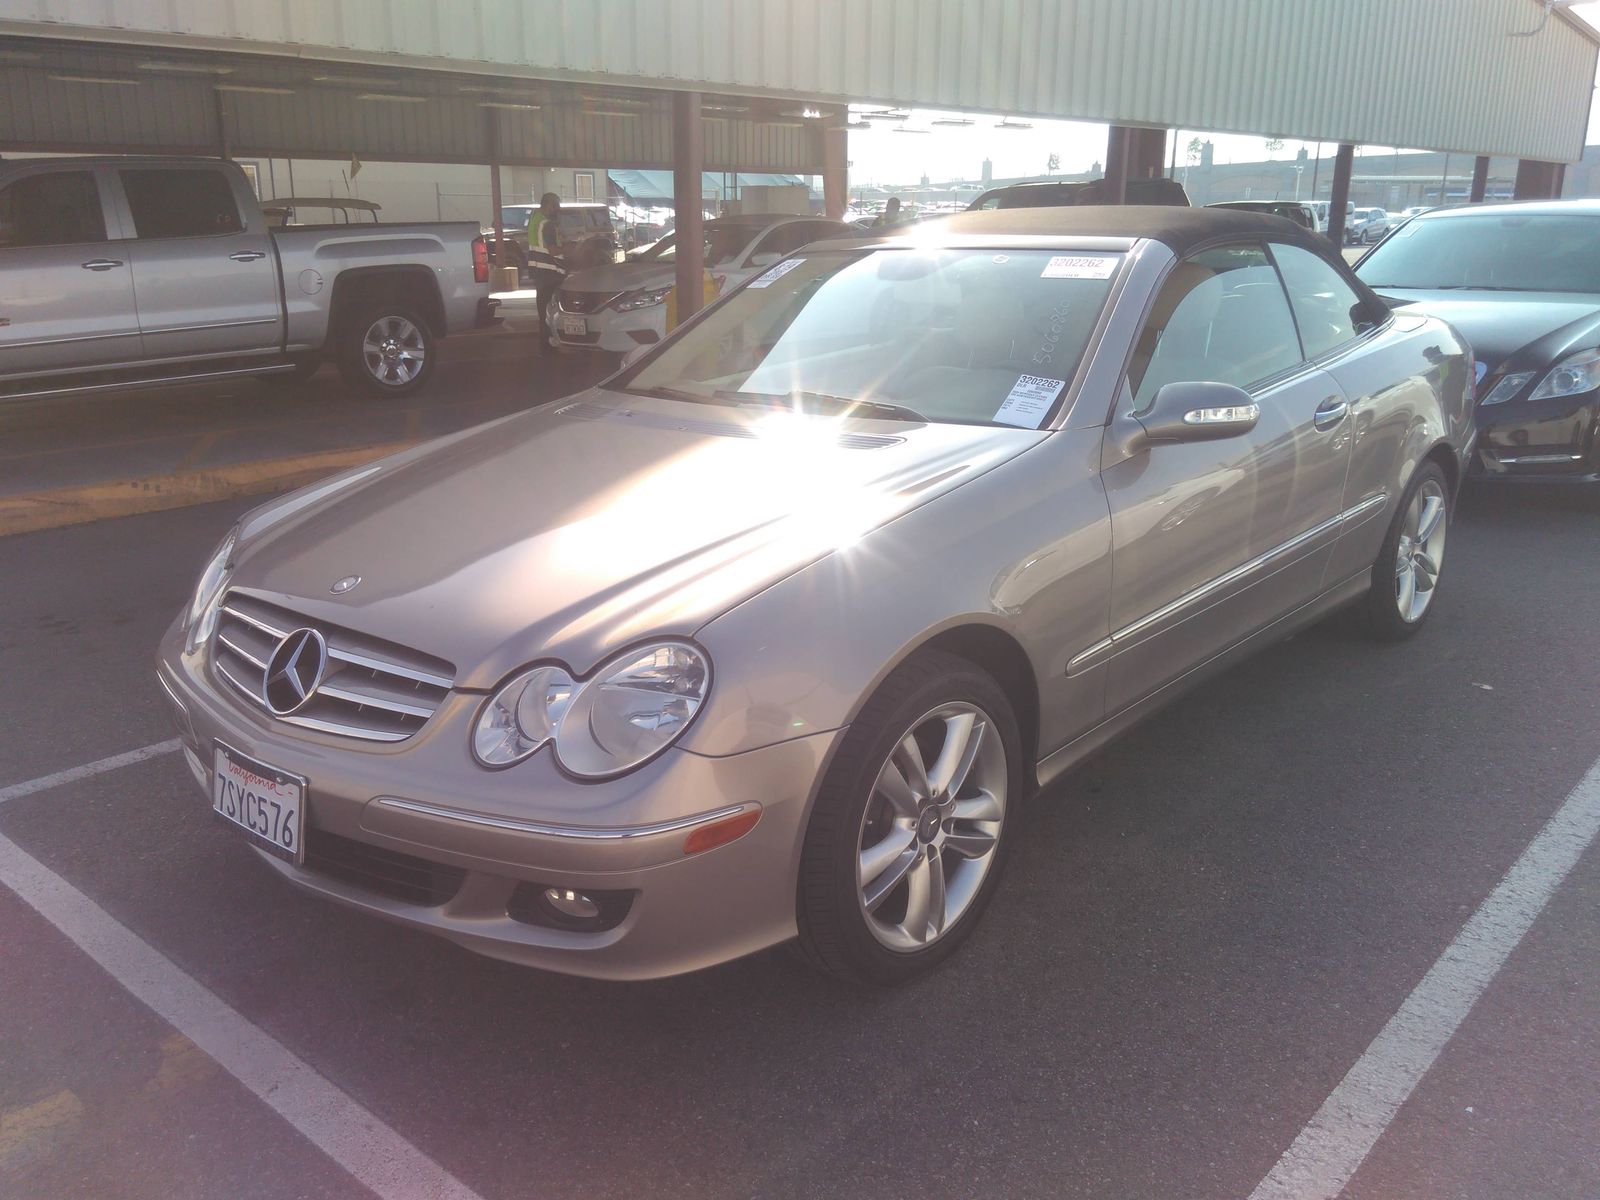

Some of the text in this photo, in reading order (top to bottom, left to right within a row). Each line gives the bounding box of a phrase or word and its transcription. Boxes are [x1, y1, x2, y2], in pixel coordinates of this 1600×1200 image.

[1050, 258, 1105, 268] 3202262
[1019, 375, 1060, 389] 3202262
[218, 772, 294, 848] 7SYC576
